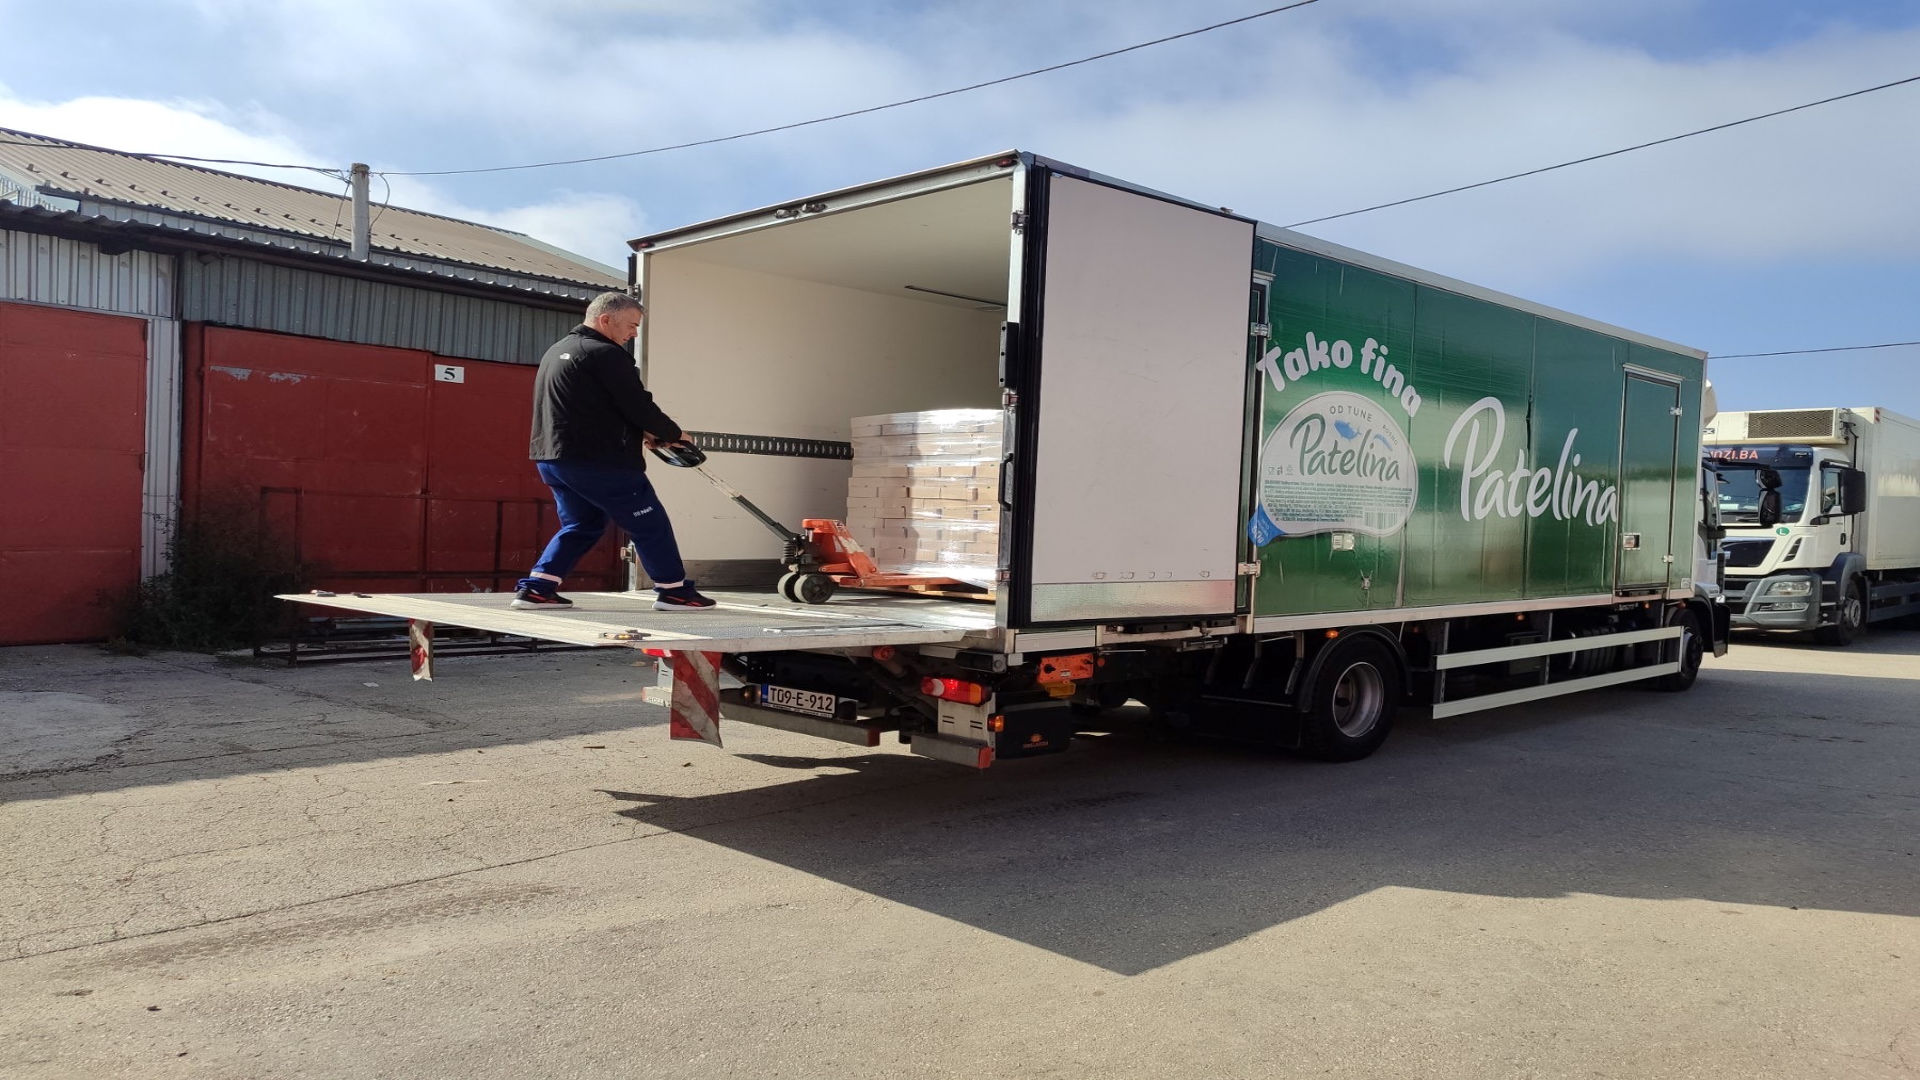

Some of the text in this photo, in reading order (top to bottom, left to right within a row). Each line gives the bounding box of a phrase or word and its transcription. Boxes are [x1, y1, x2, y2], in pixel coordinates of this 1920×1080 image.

[444, 368, 455, 381] 5
[1256, 331, 1422, 417] Tako fina
[1329, 405, 1373, 422] OD TUNE
[1290, 413, 1400, 482] Patelina
[1444, 396, 1618, 527] Patelina
[770, 687, 834, 711] T09-E-912
